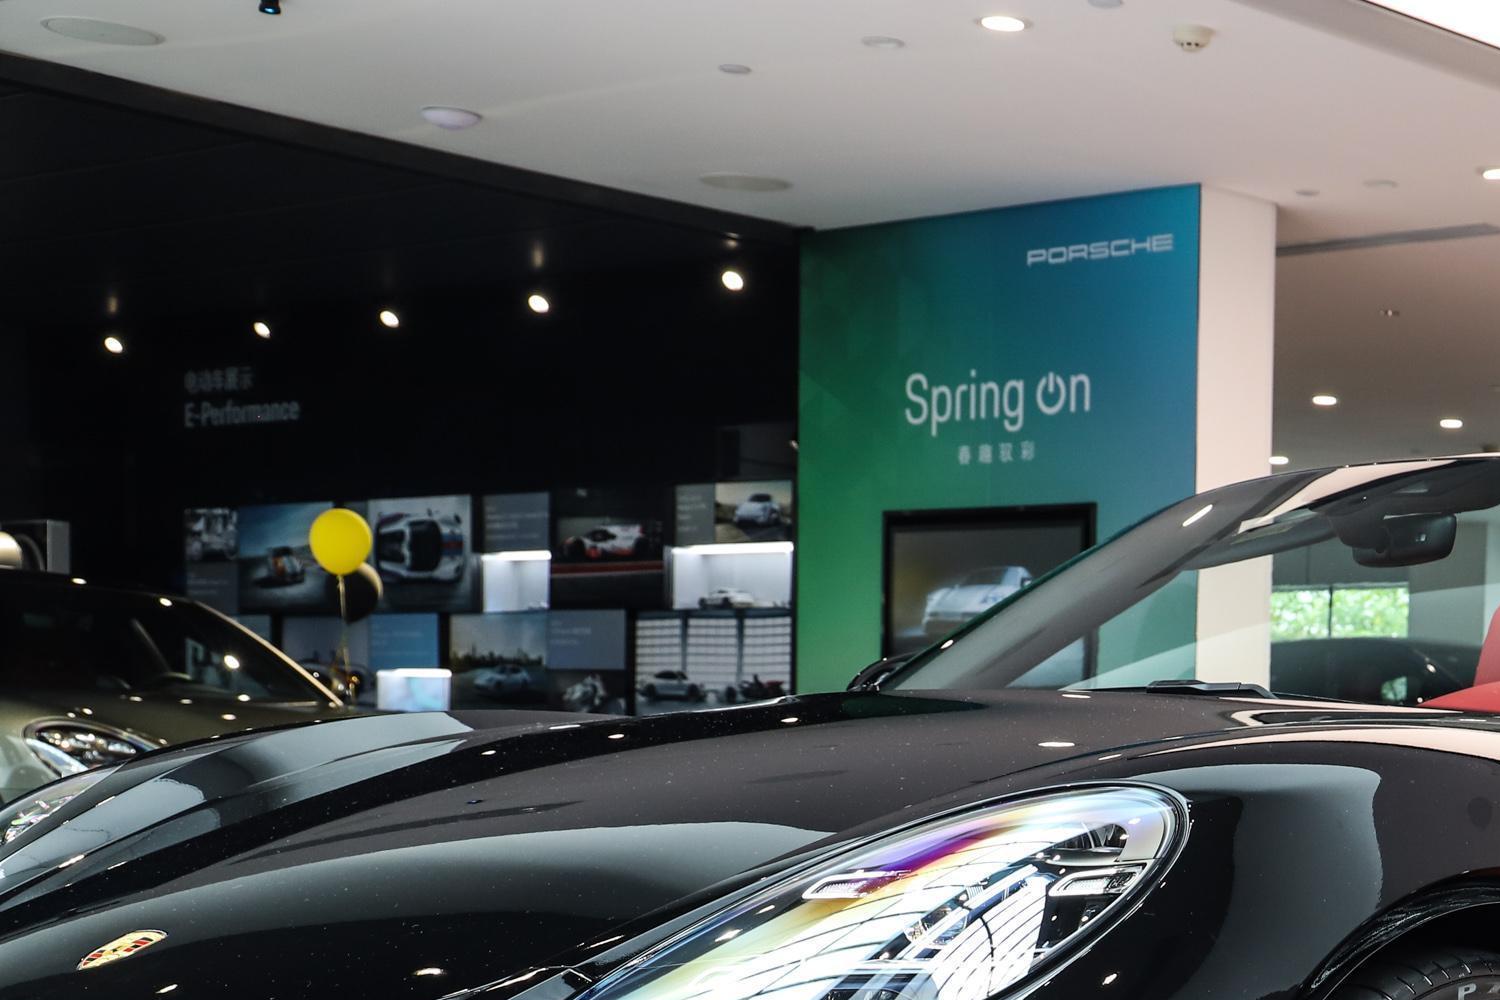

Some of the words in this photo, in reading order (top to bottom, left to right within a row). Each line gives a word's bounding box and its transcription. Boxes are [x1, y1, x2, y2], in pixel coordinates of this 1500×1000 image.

[1026, 233, 1174, 267] PORSCHE
[184, 397, 301, 428] E-Performance
[904, 368, 1025, 437] Spring
[1036, 371, 1092, 416] On
